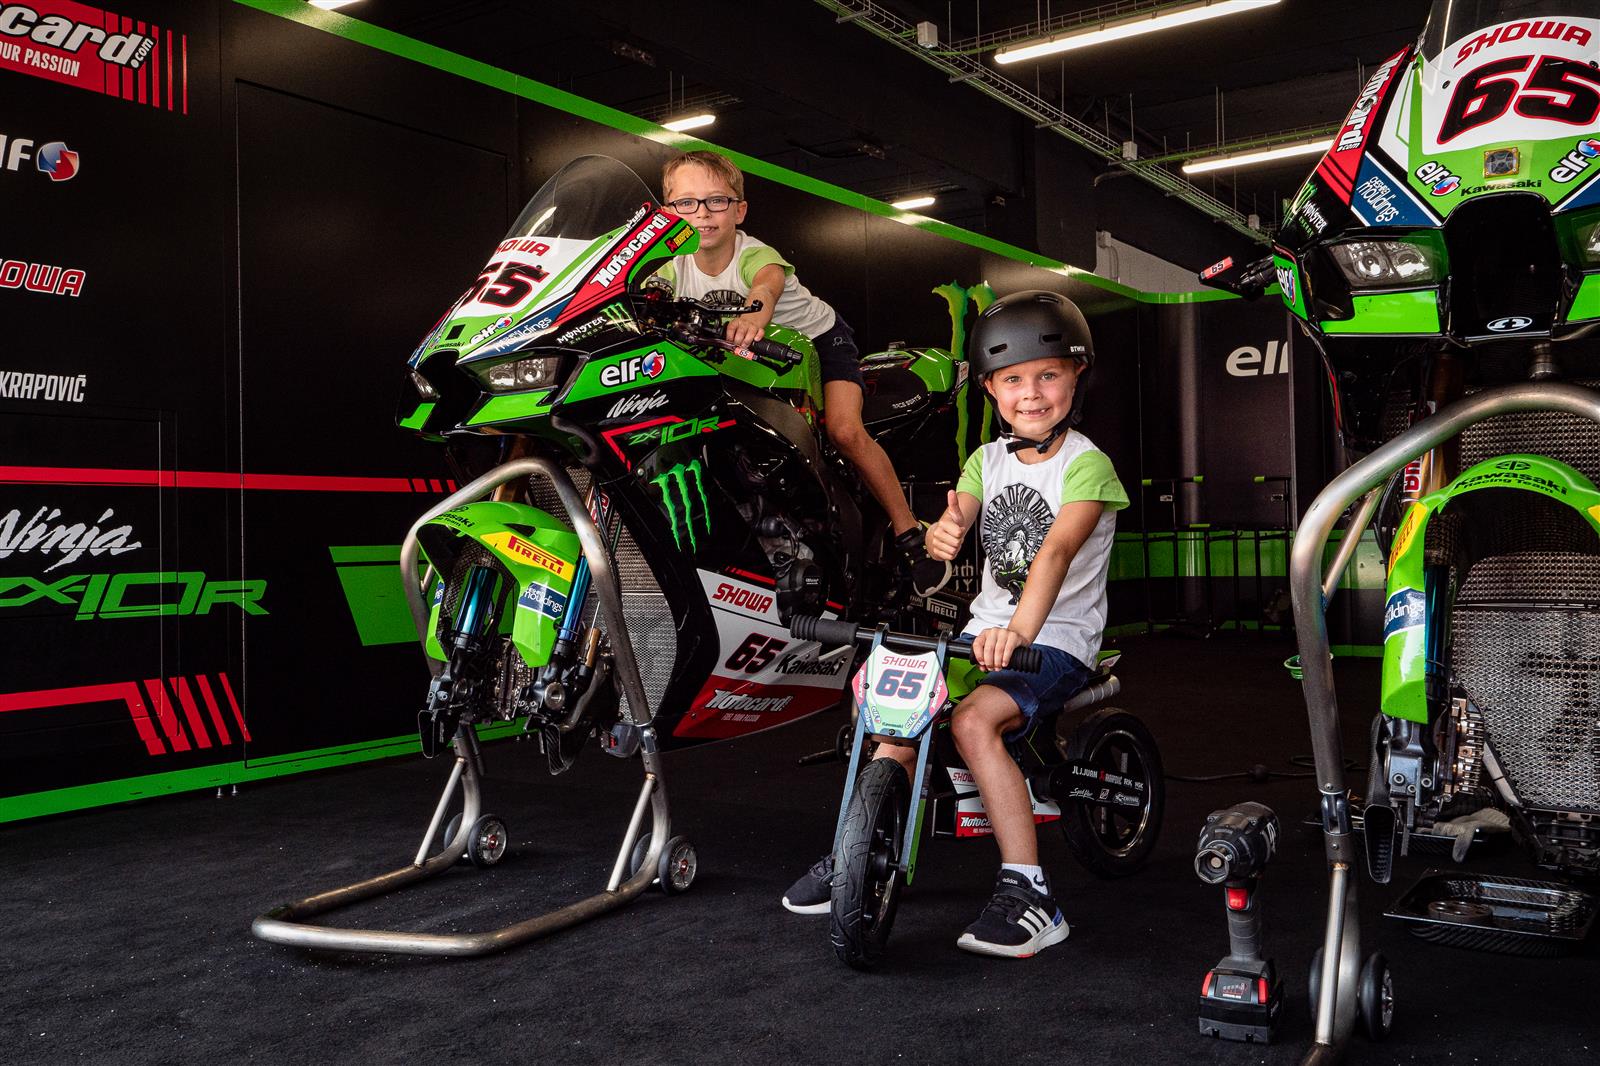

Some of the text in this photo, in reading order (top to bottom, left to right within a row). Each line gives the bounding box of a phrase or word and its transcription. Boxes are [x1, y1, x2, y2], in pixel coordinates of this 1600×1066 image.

[0, 4, 143, 66] card
[1452, 21, 1592, 69] SHOWA
[23, 48, 80, 77] PASSION
[1437, 55, 1600, 145] 65
[1416, 162, 1444, 185] elf
[1550, 152, 1590, 183] elf
[1461, 179, 1542, 196] Kawasaki
[0, 259, 87, 297] OWA
[449, 261, 550, 309] 65
[556, 315, 608, 344] MONSTER
[601, 357, 641, 386] elf
[606, 389, 670, 421] Ninja
[628, 415, 720, 446] ZX-10R
[1453, 471, 1569, 496] Kawasaki
[1514, 479, 1555, 494] Team
[0, 505, 142, 573] Ninja
[506, 535, 565, 575] PIRELLI
[712, 582, 774, 614] SHOWA
[926, 597, 958, 620] PIRELLI
[724, 632, 789, 674] 65
[774, 652, 848, 676] Kawasaki
[881, 655, 928, 670] SHOWA
[874, 668, 928, 700] 65
[952, 771, 977, 783] SHOW
[1002, 877, 1019, 886] adidas
